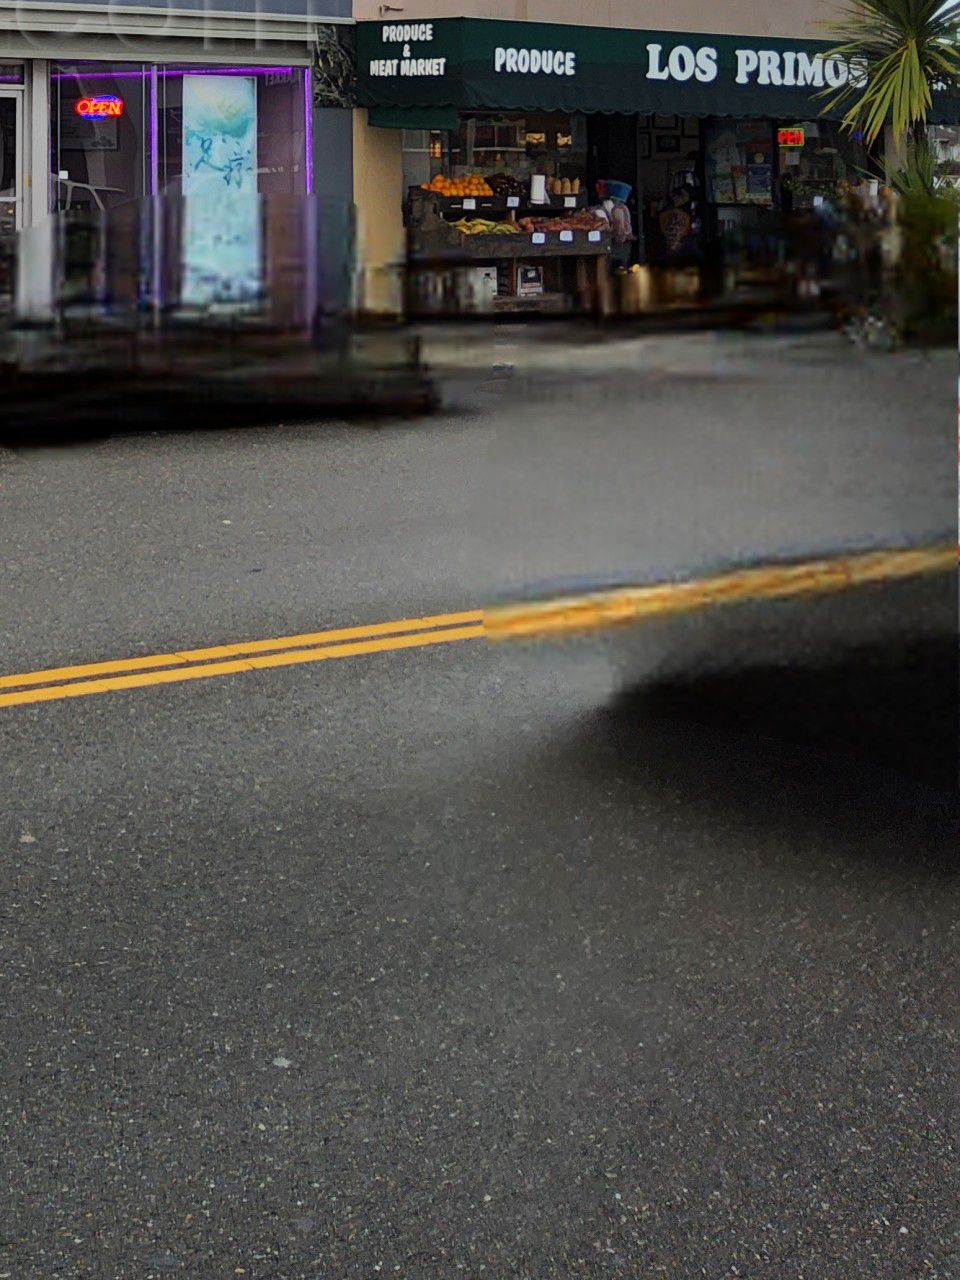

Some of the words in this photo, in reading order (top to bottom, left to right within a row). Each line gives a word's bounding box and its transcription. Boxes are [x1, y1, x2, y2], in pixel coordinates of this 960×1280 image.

[382, 23, 434, 43] PRODUCE
[402, 43, 411, 58] &
[369, 59, 398, 77] MEAT
[400, 57, 447, 77] MARKET
[494, 47, 576, 76] PRODUCE
[646, 43, 718, 82] LOS
[735, 50, 868, 88] PRIMOS
[75, 98, 124, 117] OPEN
